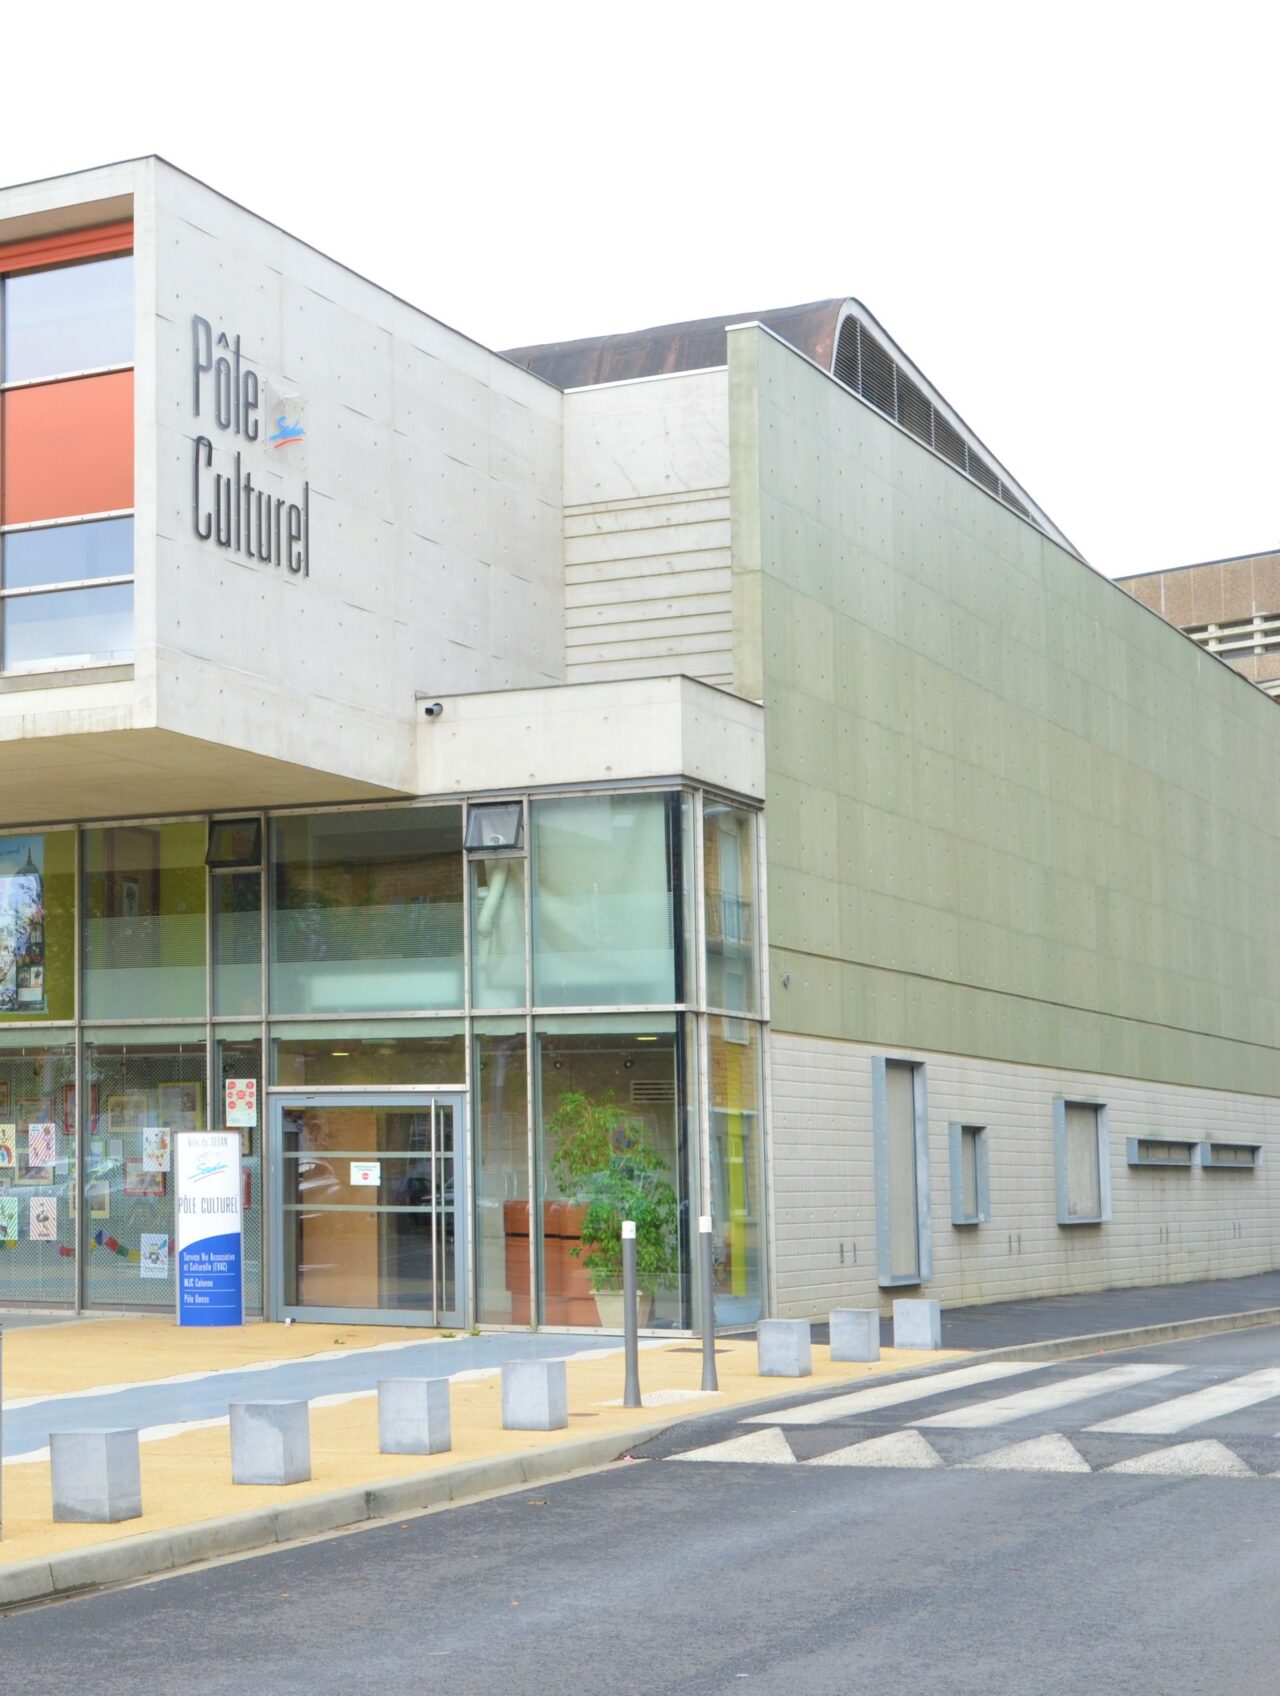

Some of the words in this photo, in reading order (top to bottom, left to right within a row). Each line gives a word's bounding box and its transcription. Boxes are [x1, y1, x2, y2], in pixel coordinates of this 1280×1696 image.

[192, 314, 259, 441] Pôle
[194, 435, 309, 578] Culturel
[210, 1136, 228, 1147] SEDAN
[178, 1195, 196, 1214] PÔLE
[201, 1196, 238, 1214] CULTUREL
